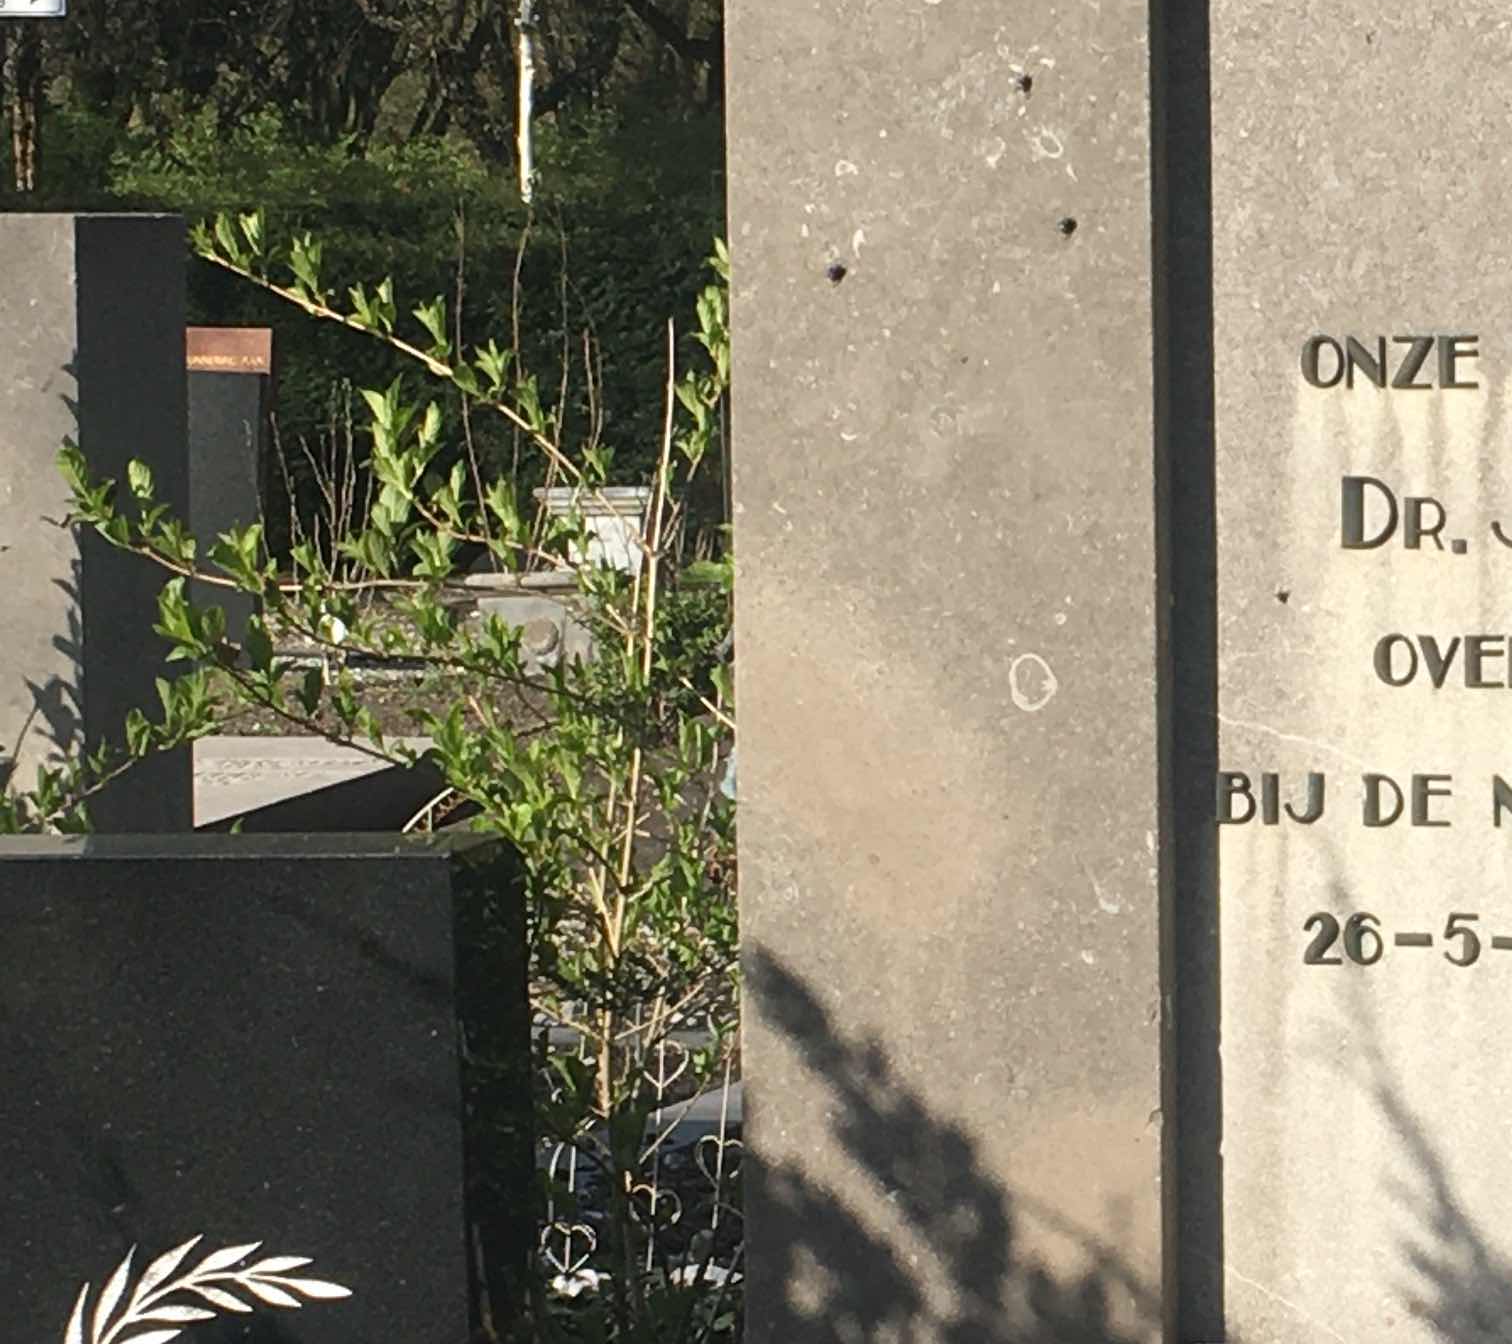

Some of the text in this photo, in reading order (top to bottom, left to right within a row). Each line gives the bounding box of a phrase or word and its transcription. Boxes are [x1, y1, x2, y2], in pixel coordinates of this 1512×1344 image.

[1300, 334, 1480, 390] ONZE
[1216, 771, 1326, 826] BIJ
[1362, 773, 1452, 828] DE
